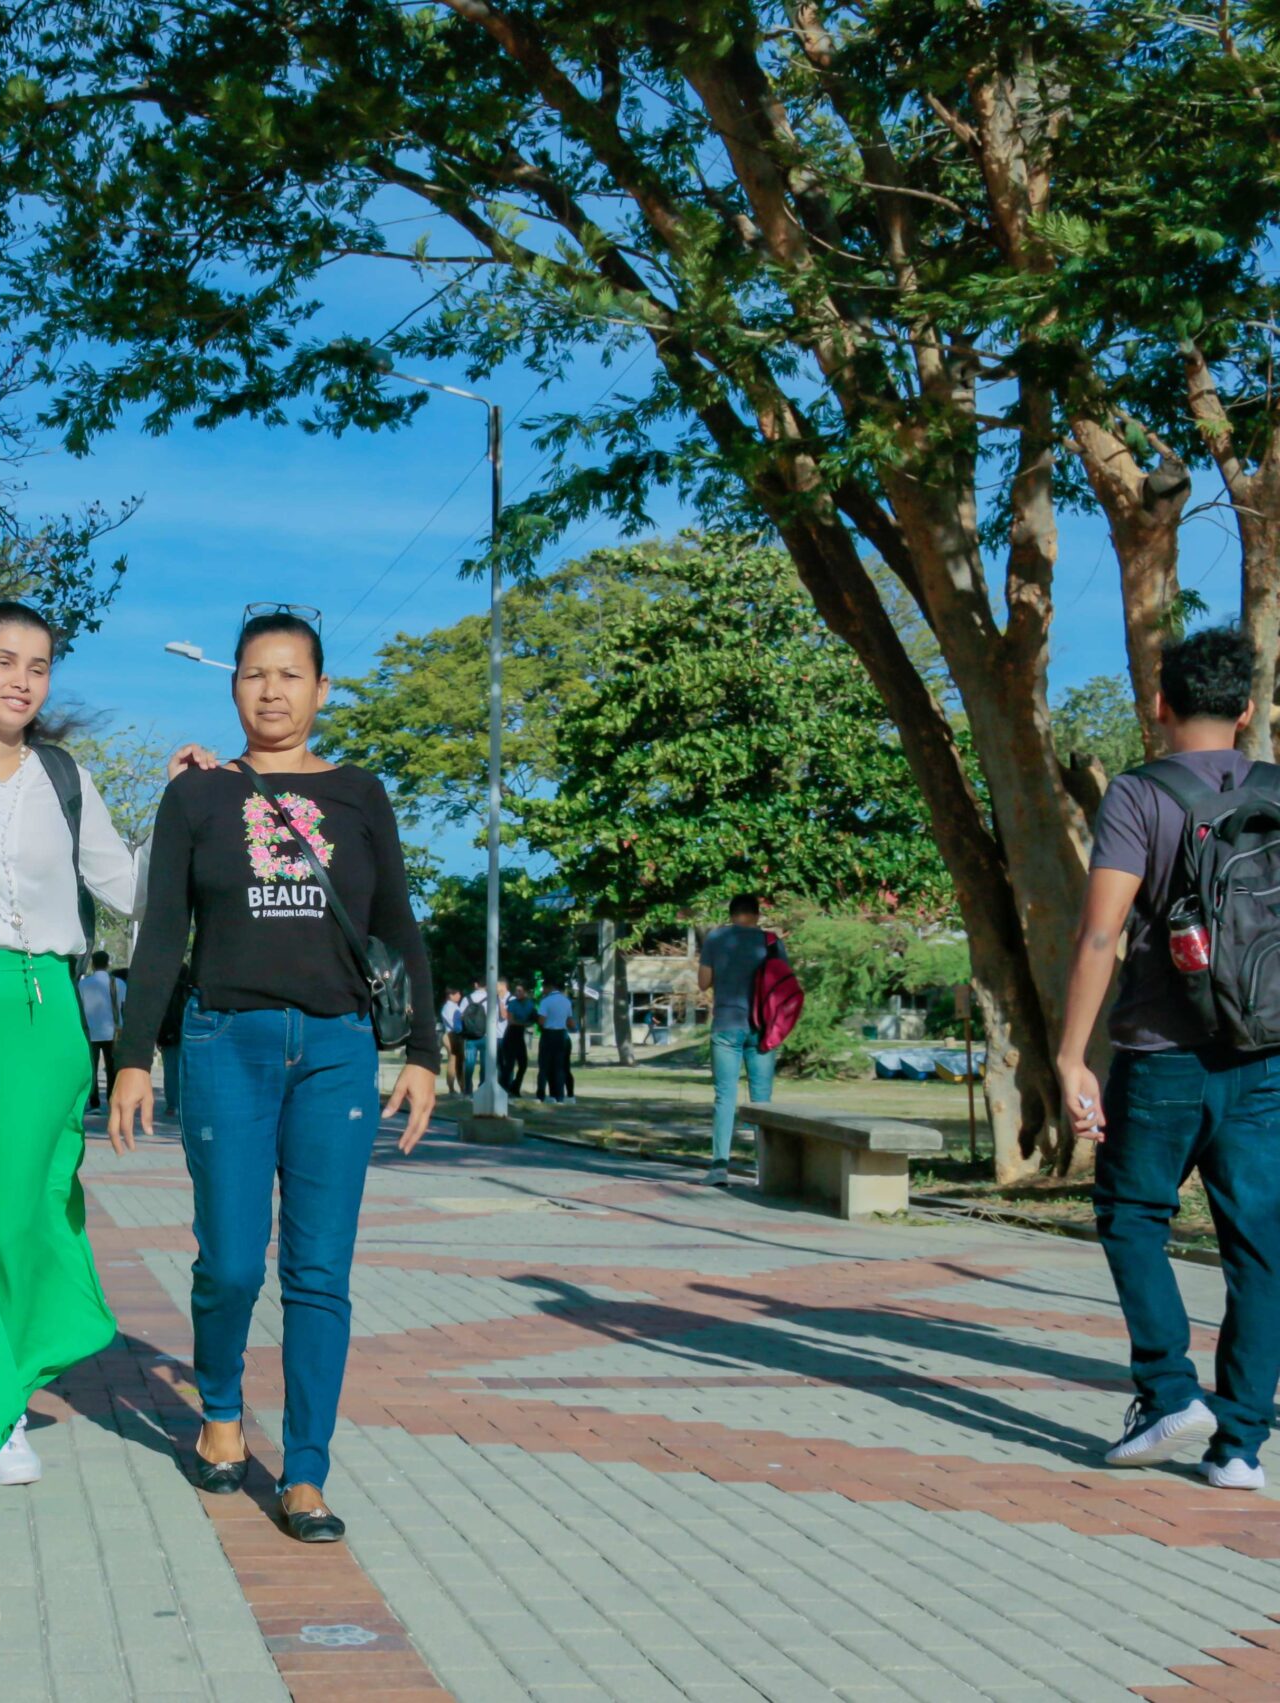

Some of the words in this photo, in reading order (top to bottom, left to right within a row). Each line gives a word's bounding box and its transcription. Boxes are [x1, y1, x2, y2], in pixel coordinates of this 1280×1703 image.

[242, 792, 334, 883] B
[262, 909, 294, 918] FASHION
[295, 909, 318, 918] LOVERS
